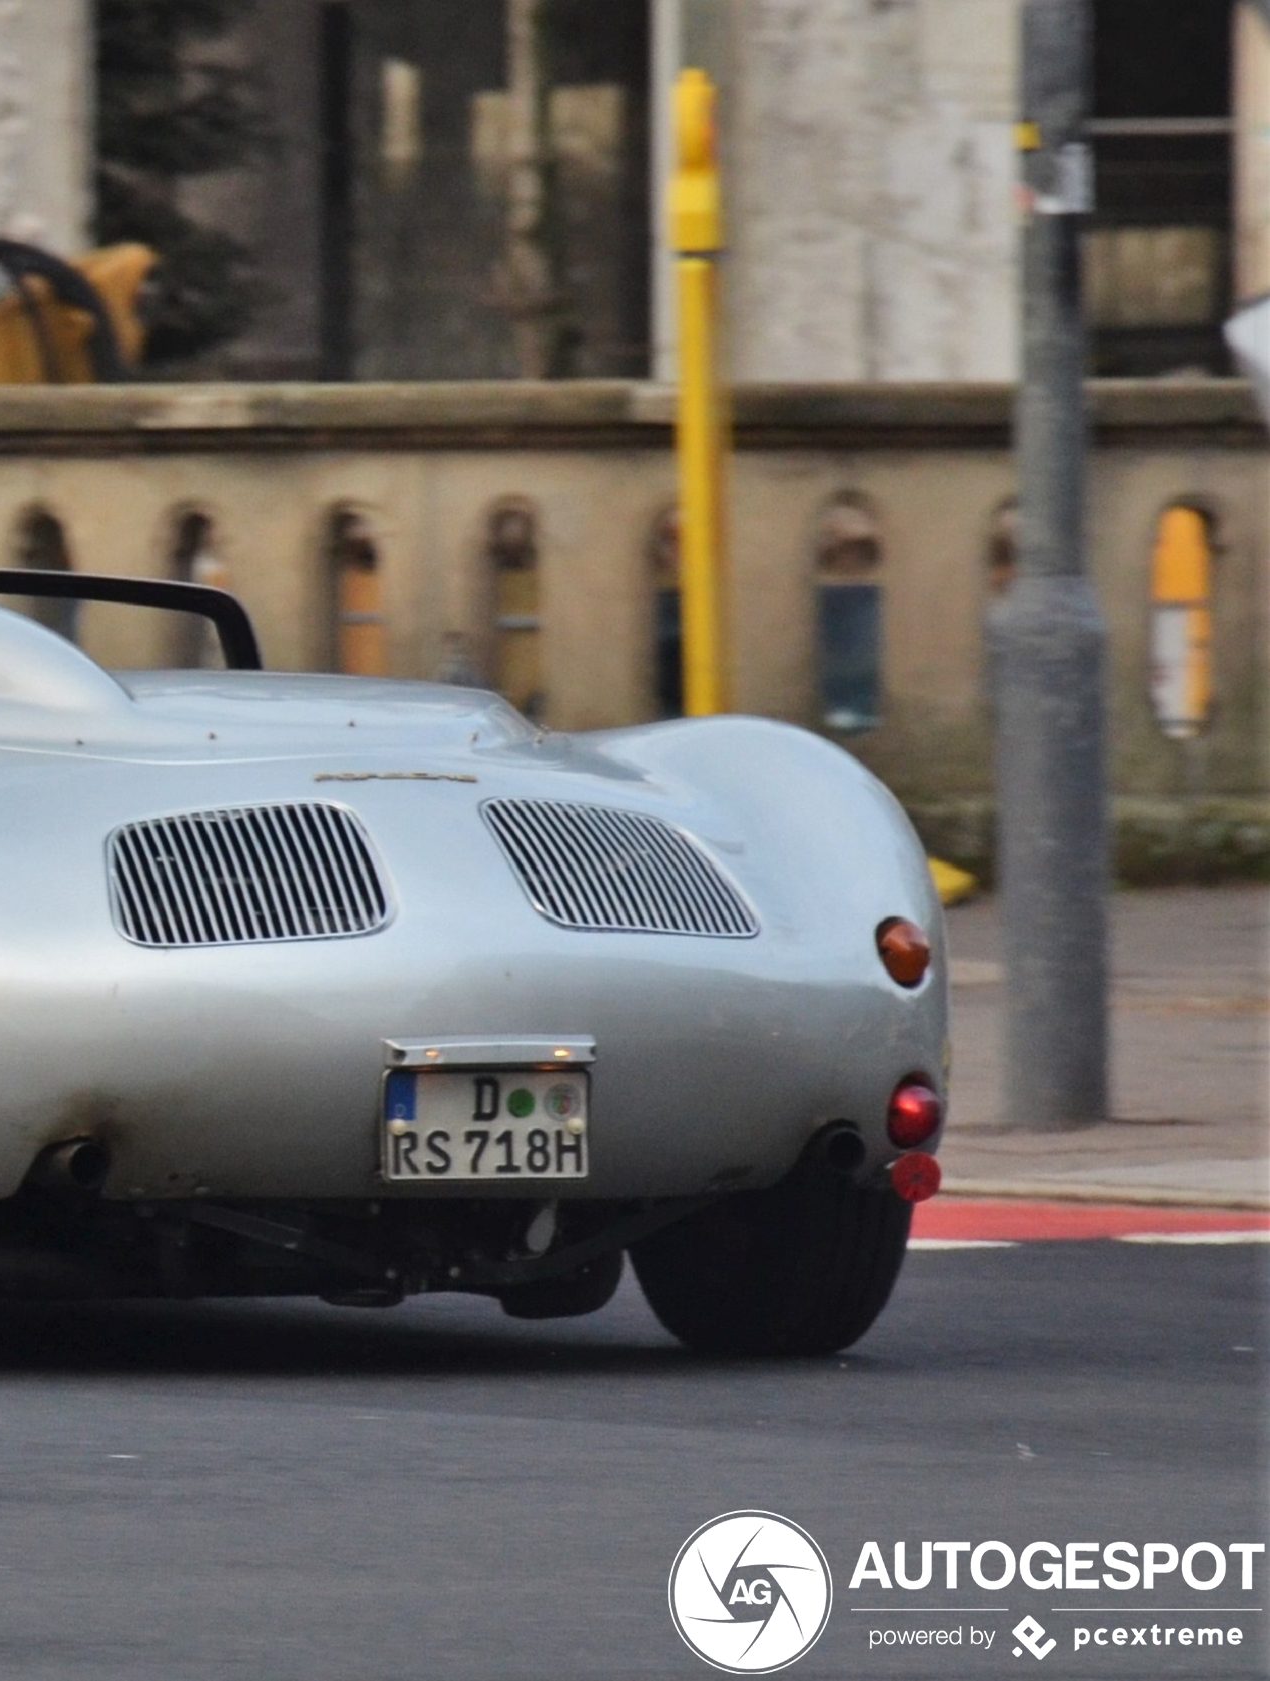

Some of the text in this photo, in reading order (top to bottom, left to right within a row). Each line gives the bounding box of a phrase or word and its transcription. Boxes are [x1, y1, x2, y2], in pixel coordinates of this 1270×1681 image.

[473, 1077, 499, 1121] D
[393, 1129, 582, 1175] RS 718H
